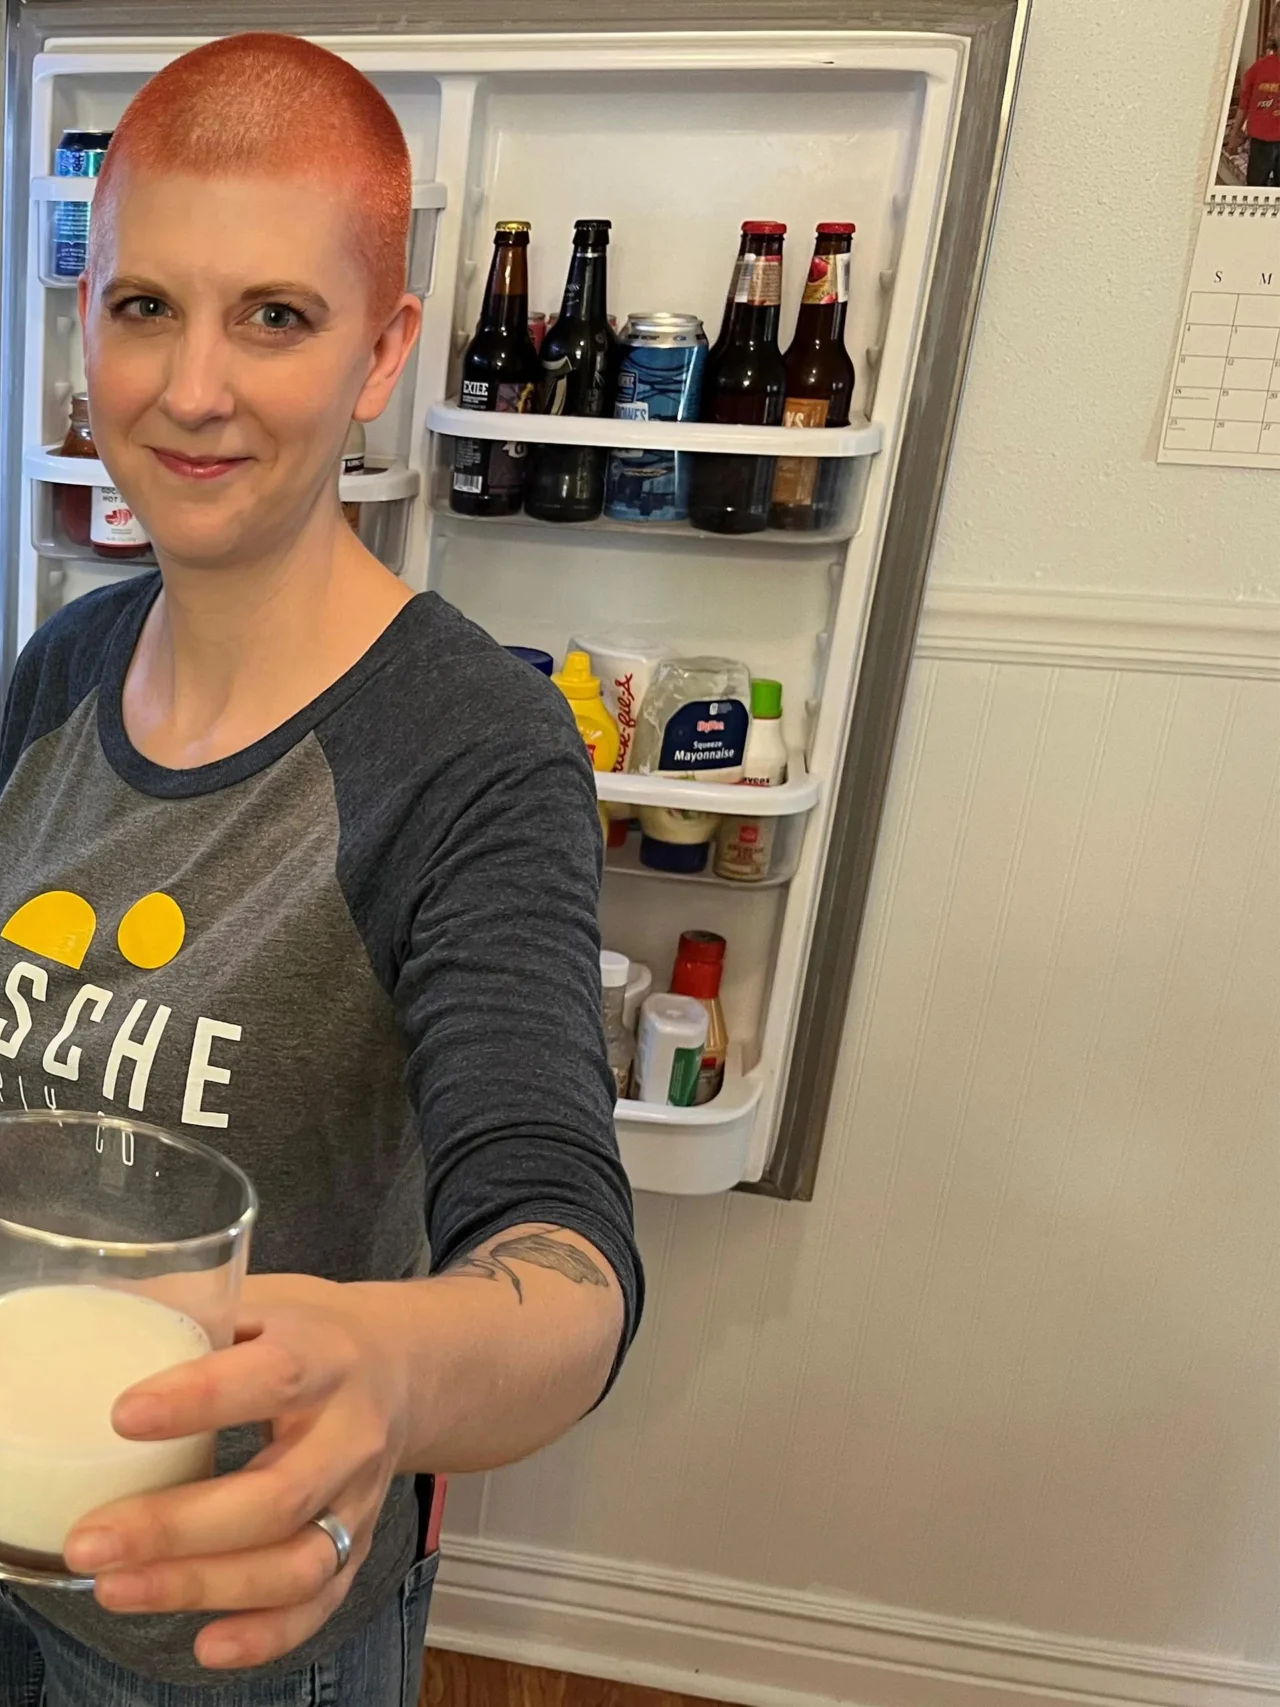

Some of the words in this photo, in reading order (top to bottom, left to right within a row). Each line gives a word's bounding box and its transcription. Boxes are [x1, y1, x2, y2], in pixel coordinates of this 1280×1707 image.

[1214, 270, 1222, 284] S
[1259, 272, 1273, 286] M
[462, 380, 489, 396] EXILE
[1268, 391, 1277, 399] 20
[1263, 423, 1271, 431] 27
[693, 740, 723, 750] Squeeze
[674, 748, 735, 763] Mayonnaise
